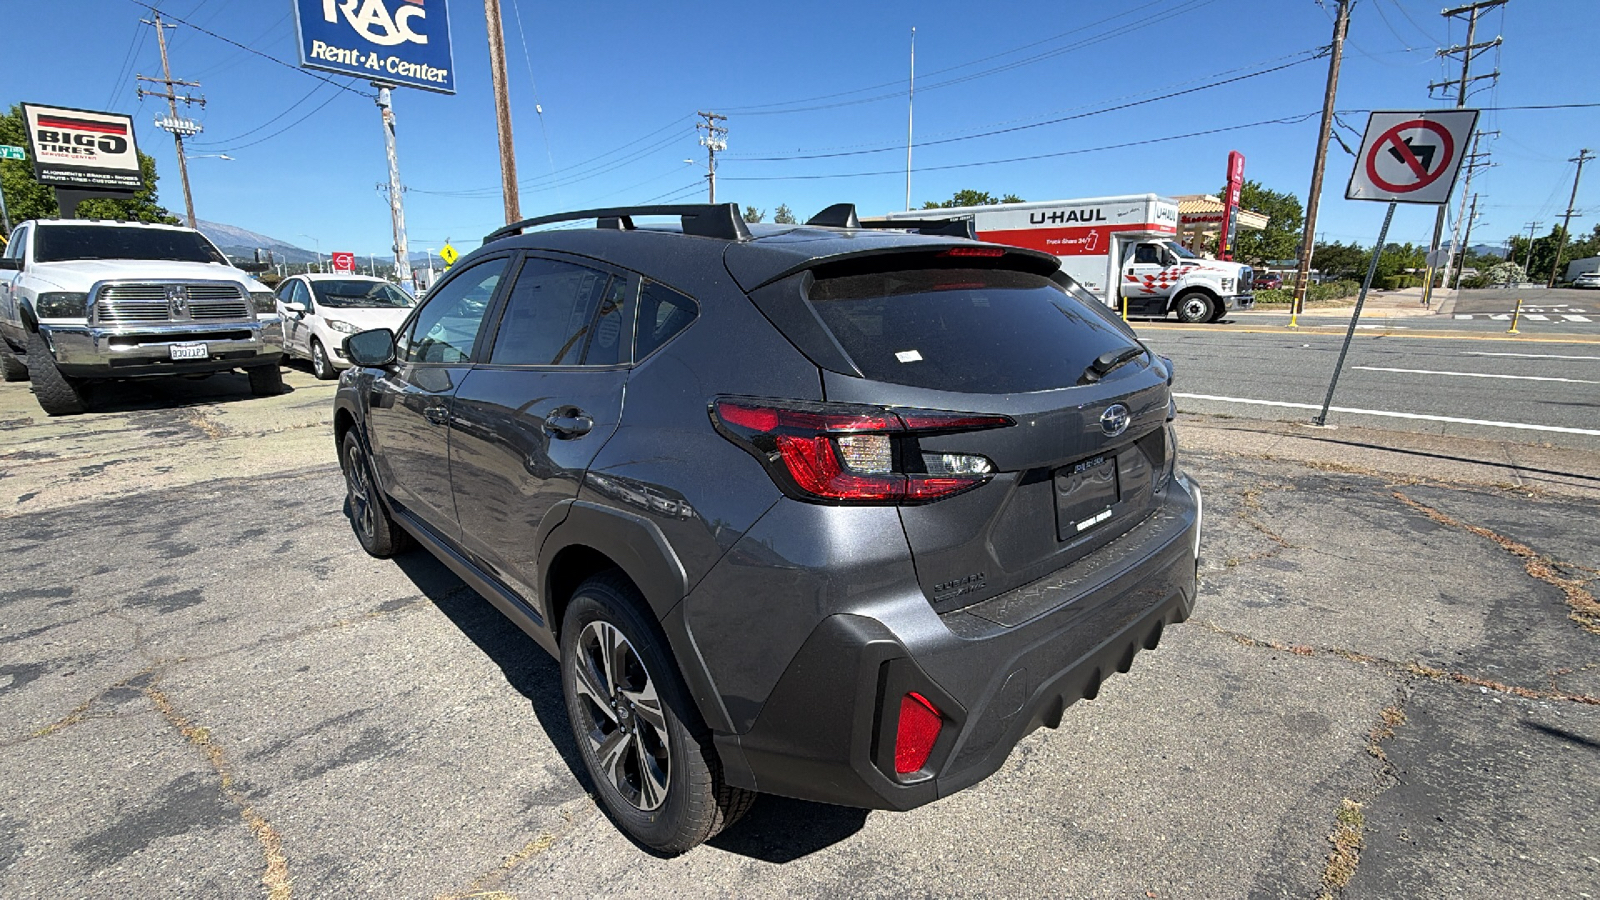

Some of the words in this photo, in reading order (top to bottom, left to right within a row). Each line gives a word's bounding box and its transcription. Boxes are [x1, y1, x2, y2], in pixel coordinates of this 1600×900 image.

[322, 0, 428, 46] RAC
[37, 129, 95, 147] BIG
[38, 143, 96, 156] TIRES
[1029, 208, 1107, 224] U-HAUL
